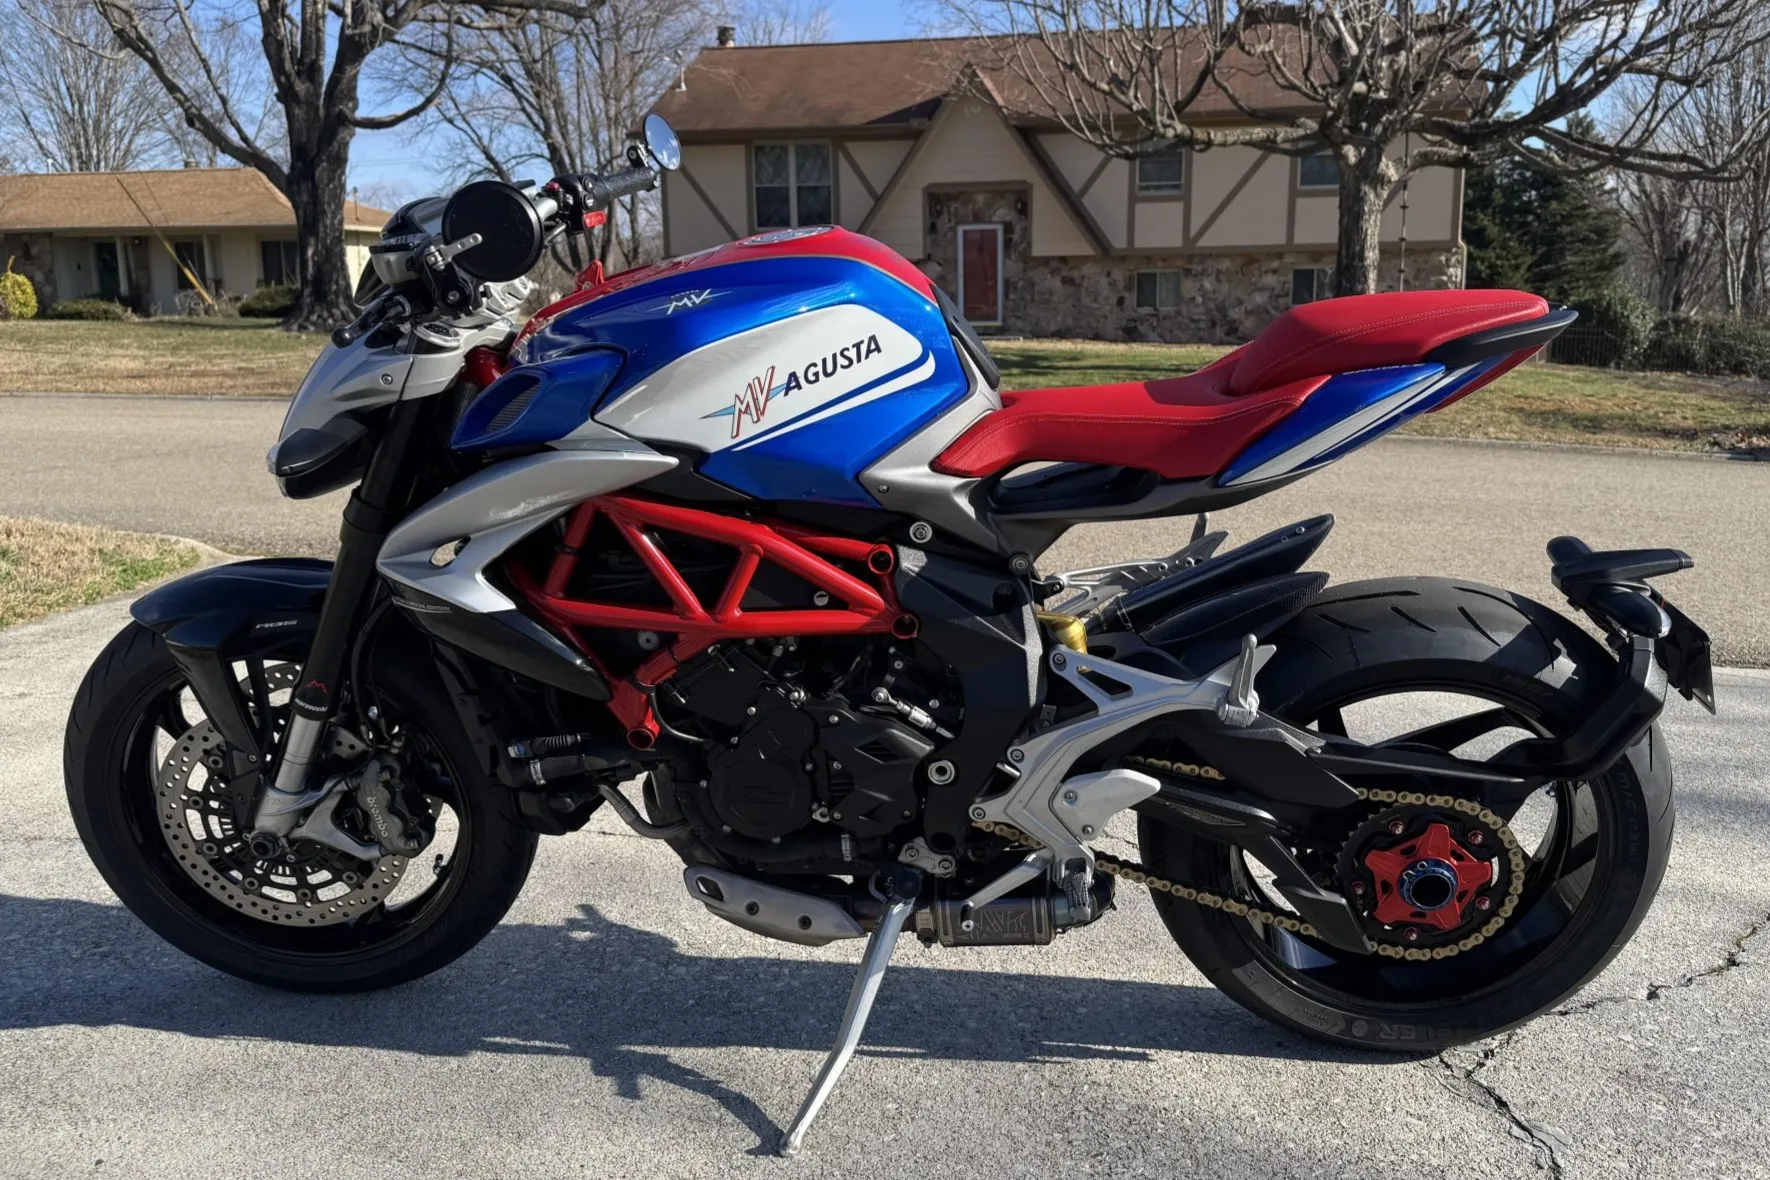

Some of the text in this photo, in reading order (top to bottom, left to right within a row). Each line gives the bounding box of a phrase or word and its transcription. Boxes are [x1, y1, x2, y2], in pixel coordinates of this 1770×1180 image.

[666, 288, 711, 316] MV
[731, 334, 882, 439] MV AGUSTA
[367, 796, 388, 837] brembo
